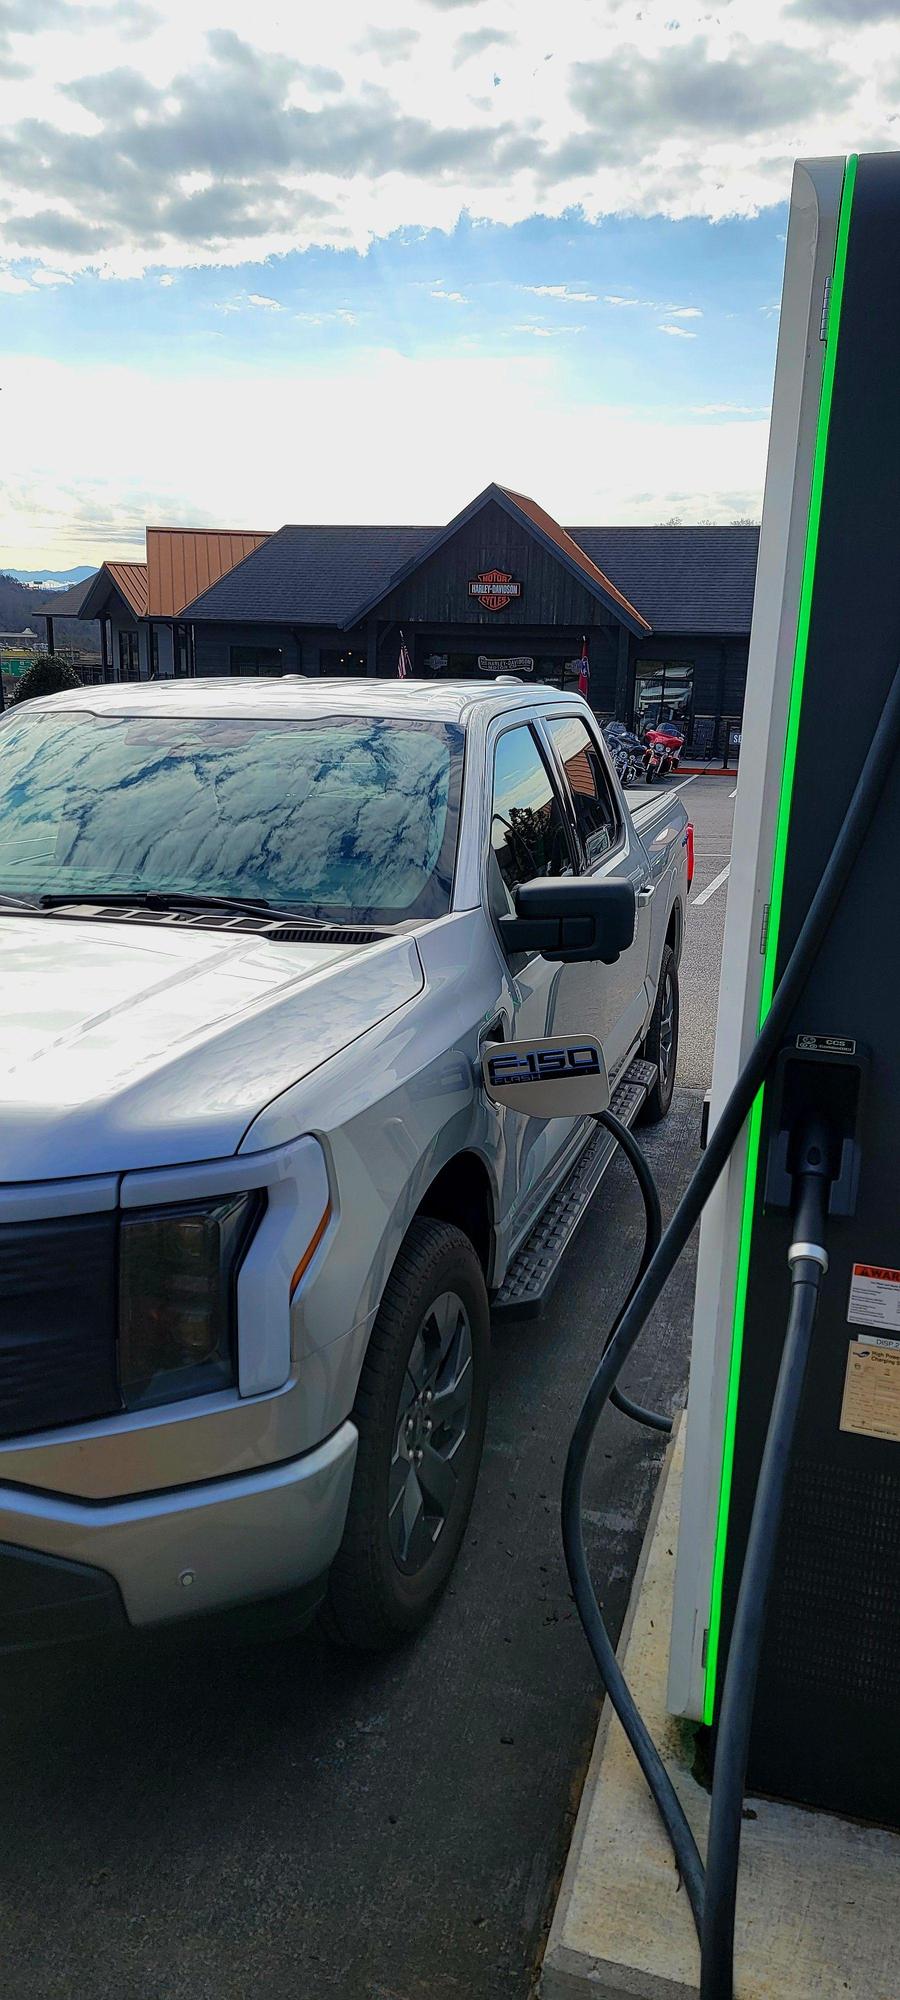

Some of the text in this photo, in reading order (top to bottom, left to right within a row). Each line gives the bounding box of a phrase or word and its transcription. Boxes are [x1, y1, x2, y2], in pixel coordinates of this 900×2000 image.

[482, 572, 508, 582] MOTOR
[471, 584, 518, 595] HARLEY-DAVIDSON
[481, 596, 507, 608] CYCLES
[488, 1045, 599, 1073] F-150
[494, 1074, 541, 1084] FLASH
